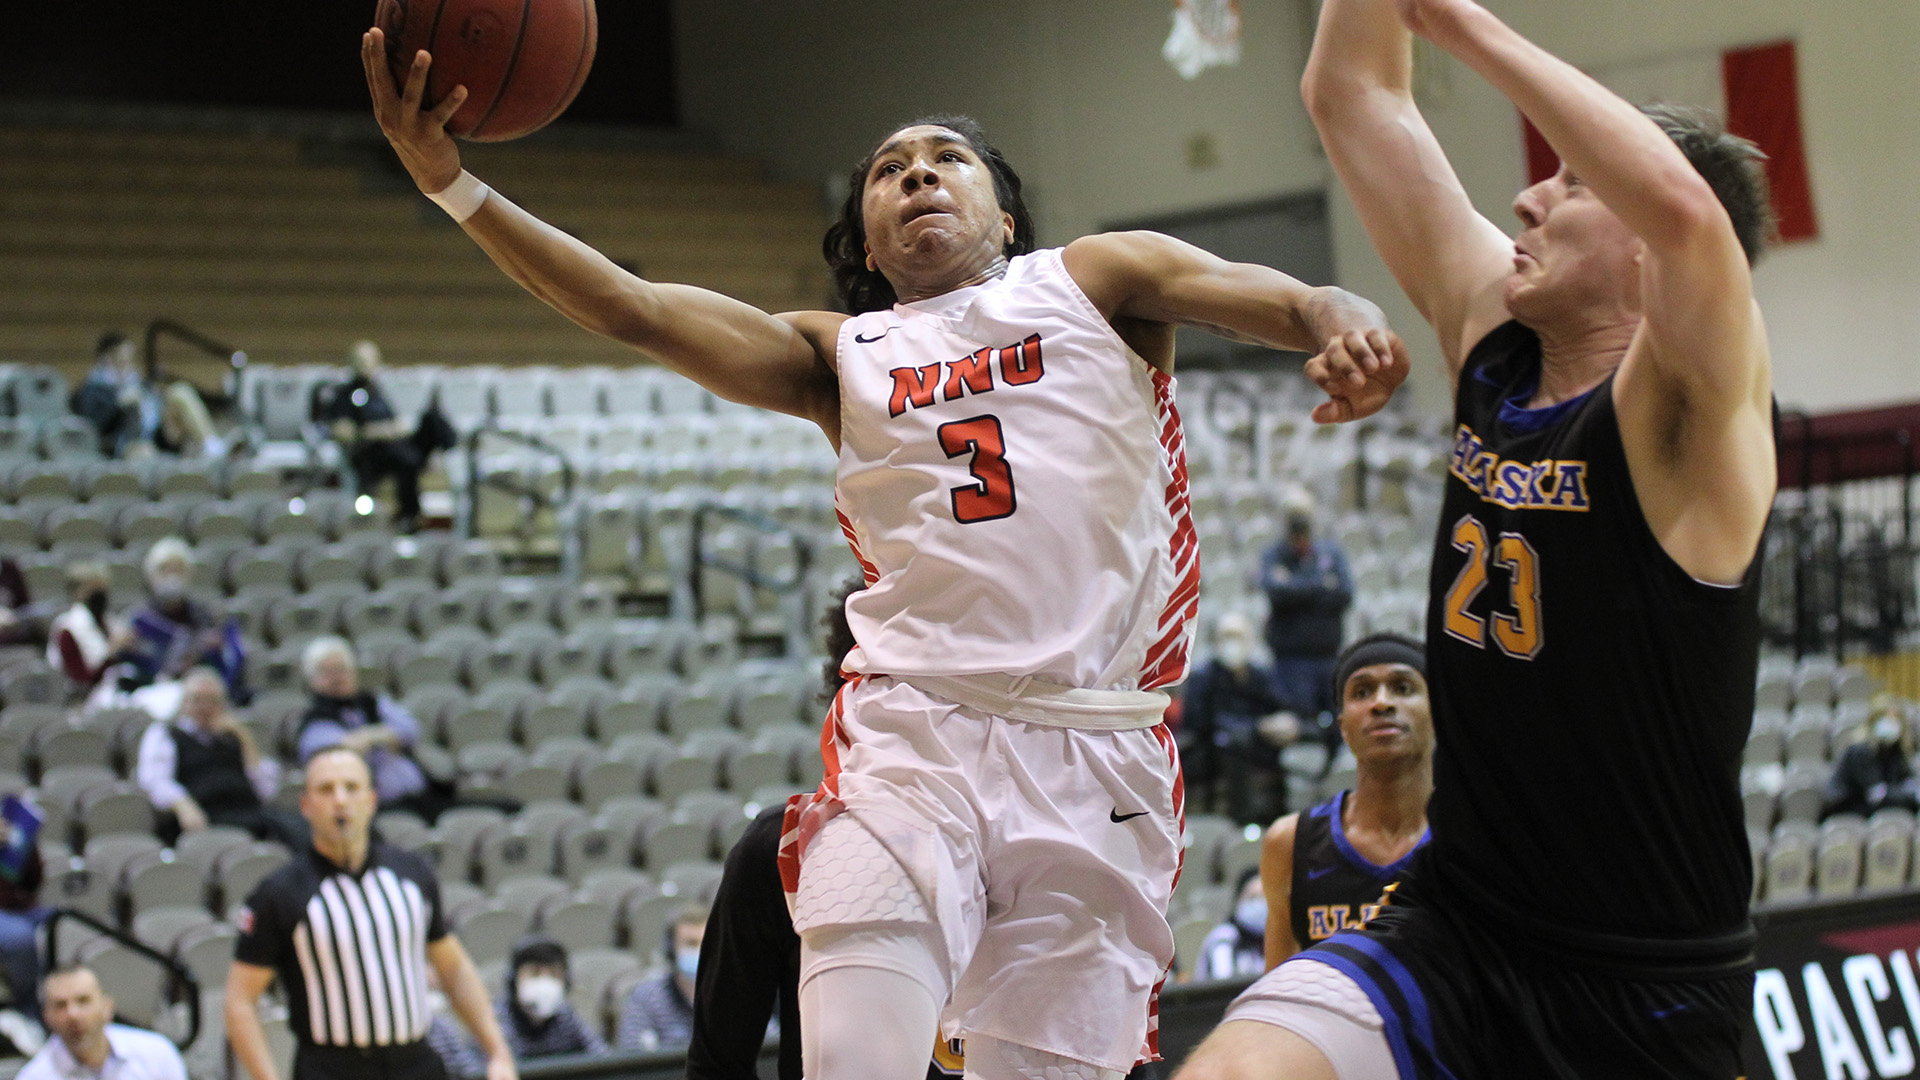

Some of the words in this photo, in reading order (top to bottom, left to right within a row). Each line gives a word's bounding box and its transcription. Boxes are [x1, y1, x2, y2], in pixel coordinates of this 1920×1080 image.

[888, 332, 1045, 418] NNU
[937, 414, 1017, 525] 3
[1450, 423, 1590, 512] ALASKA
[1443, 513, 1545, 661] 23
[1753, 948, 1920, 1080] PACI
